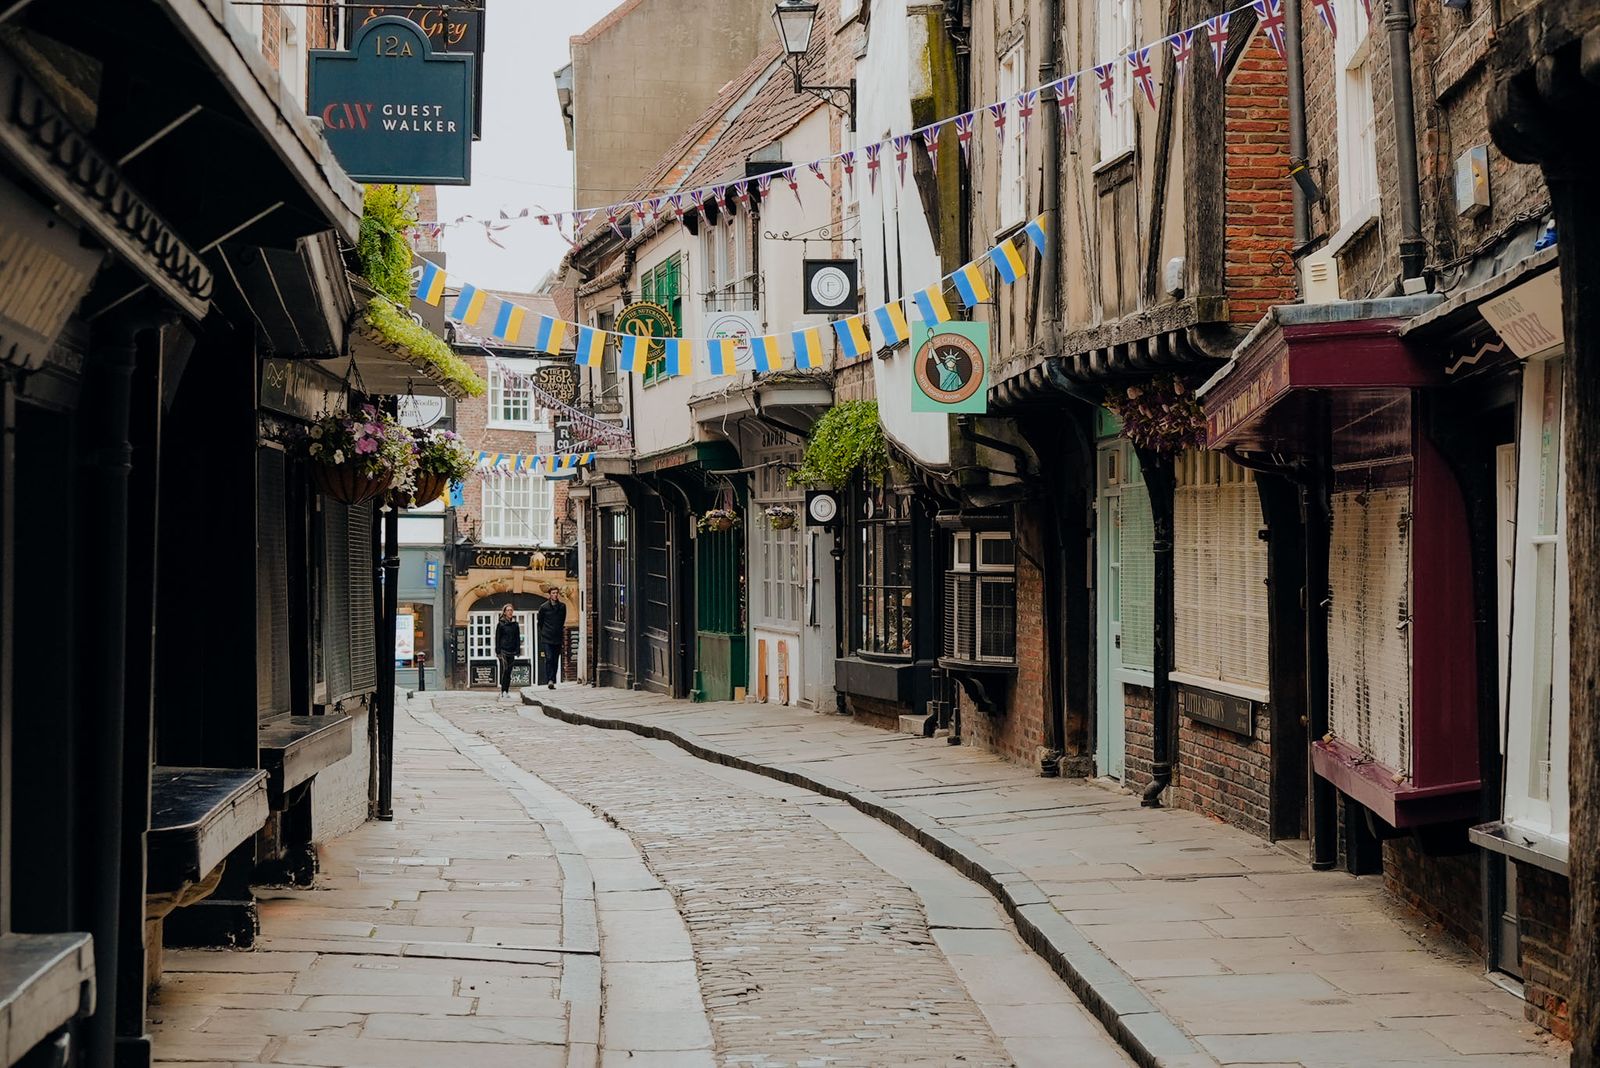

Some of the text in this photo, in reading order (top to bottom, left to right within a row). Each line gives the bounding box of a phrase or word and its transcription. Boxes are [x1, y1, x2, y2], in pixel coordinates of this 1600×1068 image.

[376, 35, 412, 56] 12A
[383, 105, 442, 116] GUEST
[383, 120, 457, 132] WALKER
[1502, 312, 1557, 352] YORK
[539, 369, 571, 383] SHOP
[547, 367, 560, 375] THE
[476, 554, 511, 567] Golden
